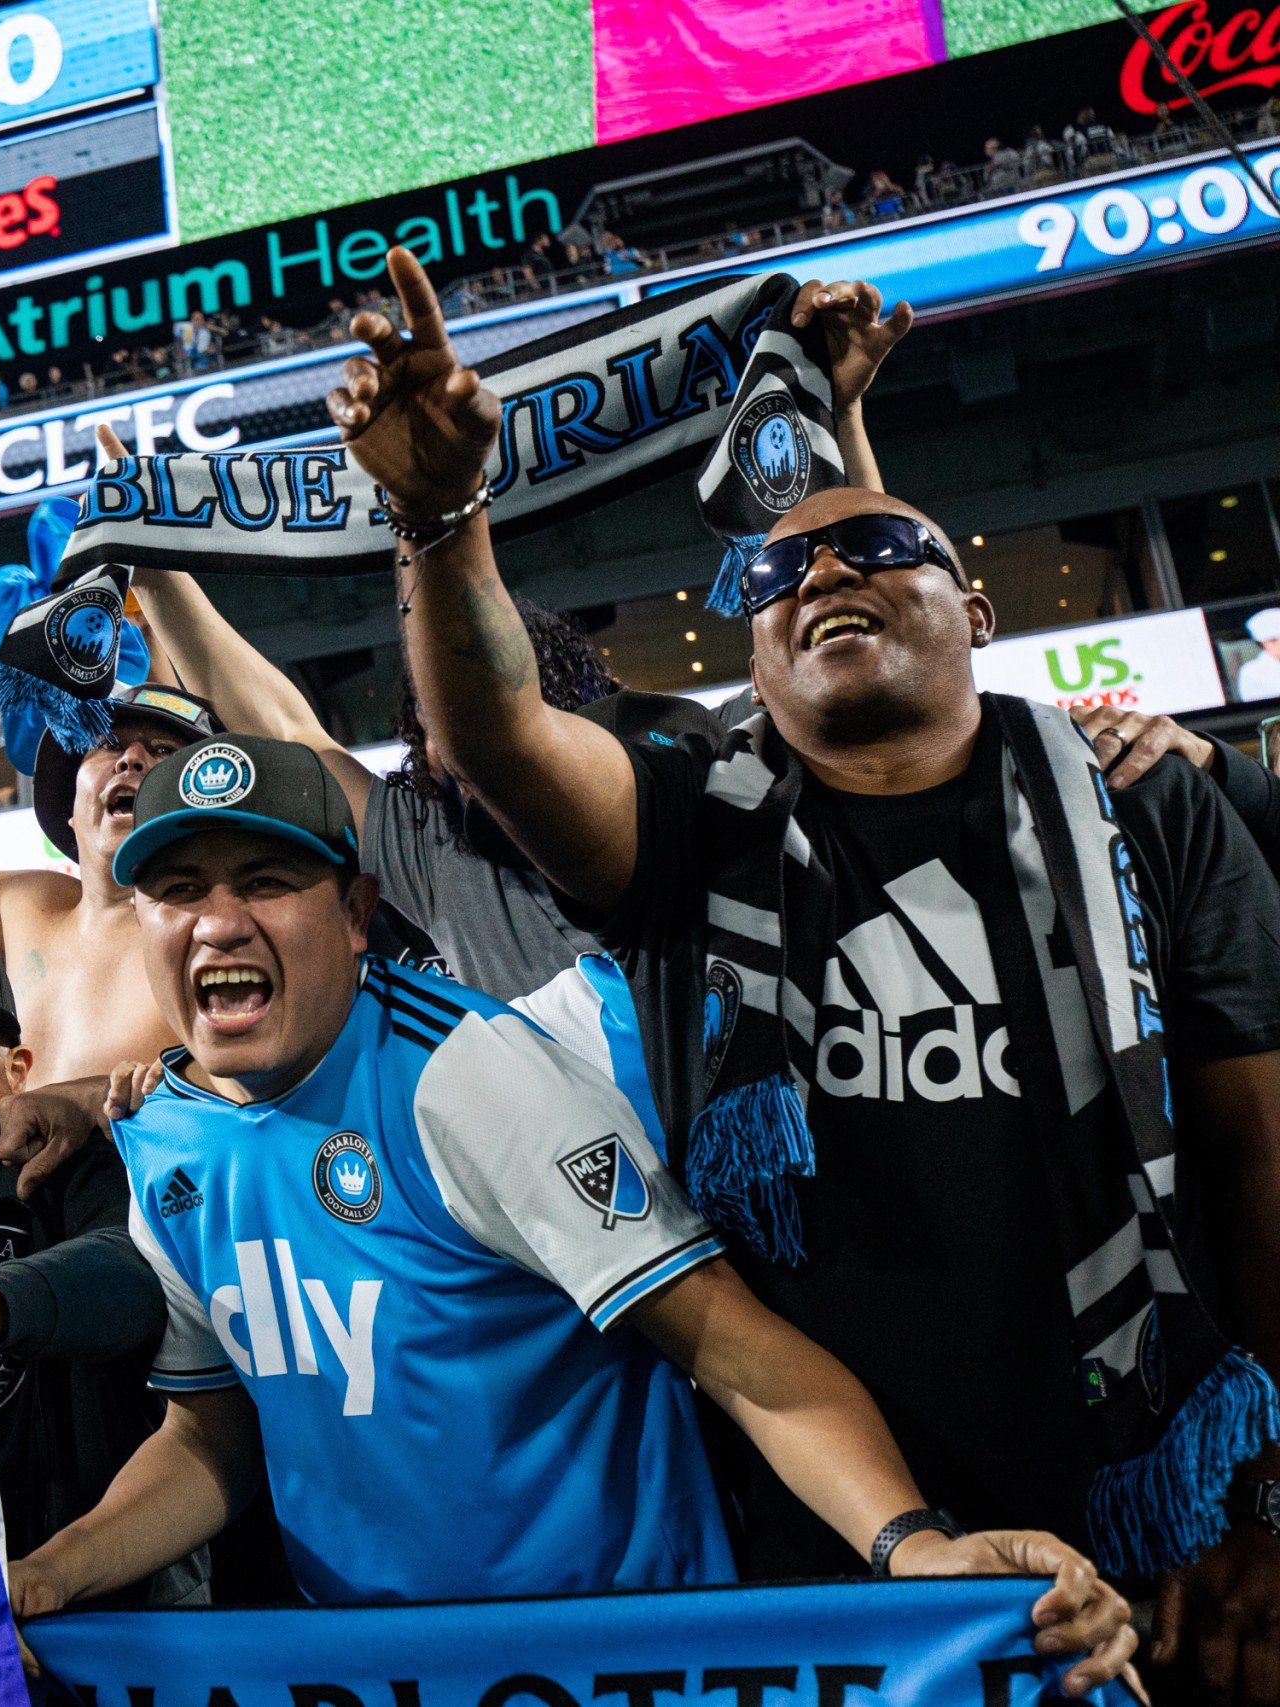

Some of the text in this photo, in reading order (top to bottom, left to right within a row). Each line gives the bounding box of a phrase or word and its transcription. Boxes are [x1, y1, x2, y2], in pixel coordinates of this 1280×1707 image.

[267, 174, 563, 299] Health
[74, 448, 352, 533] BLUE
[70, 592, 102, 605] BLUE
[189, 748, 245, 770] CHARLOTTE
[186, 787, 245, 806] FOOTBALL CLUB
[323, 1136, 375, 1164] CHARLOTTE
[571, 1149, 611, 1180] MLS
[161, 1192, 204, 1218] adidas
[323, 1192, 377, 1218] FOOTBALL CLUB
